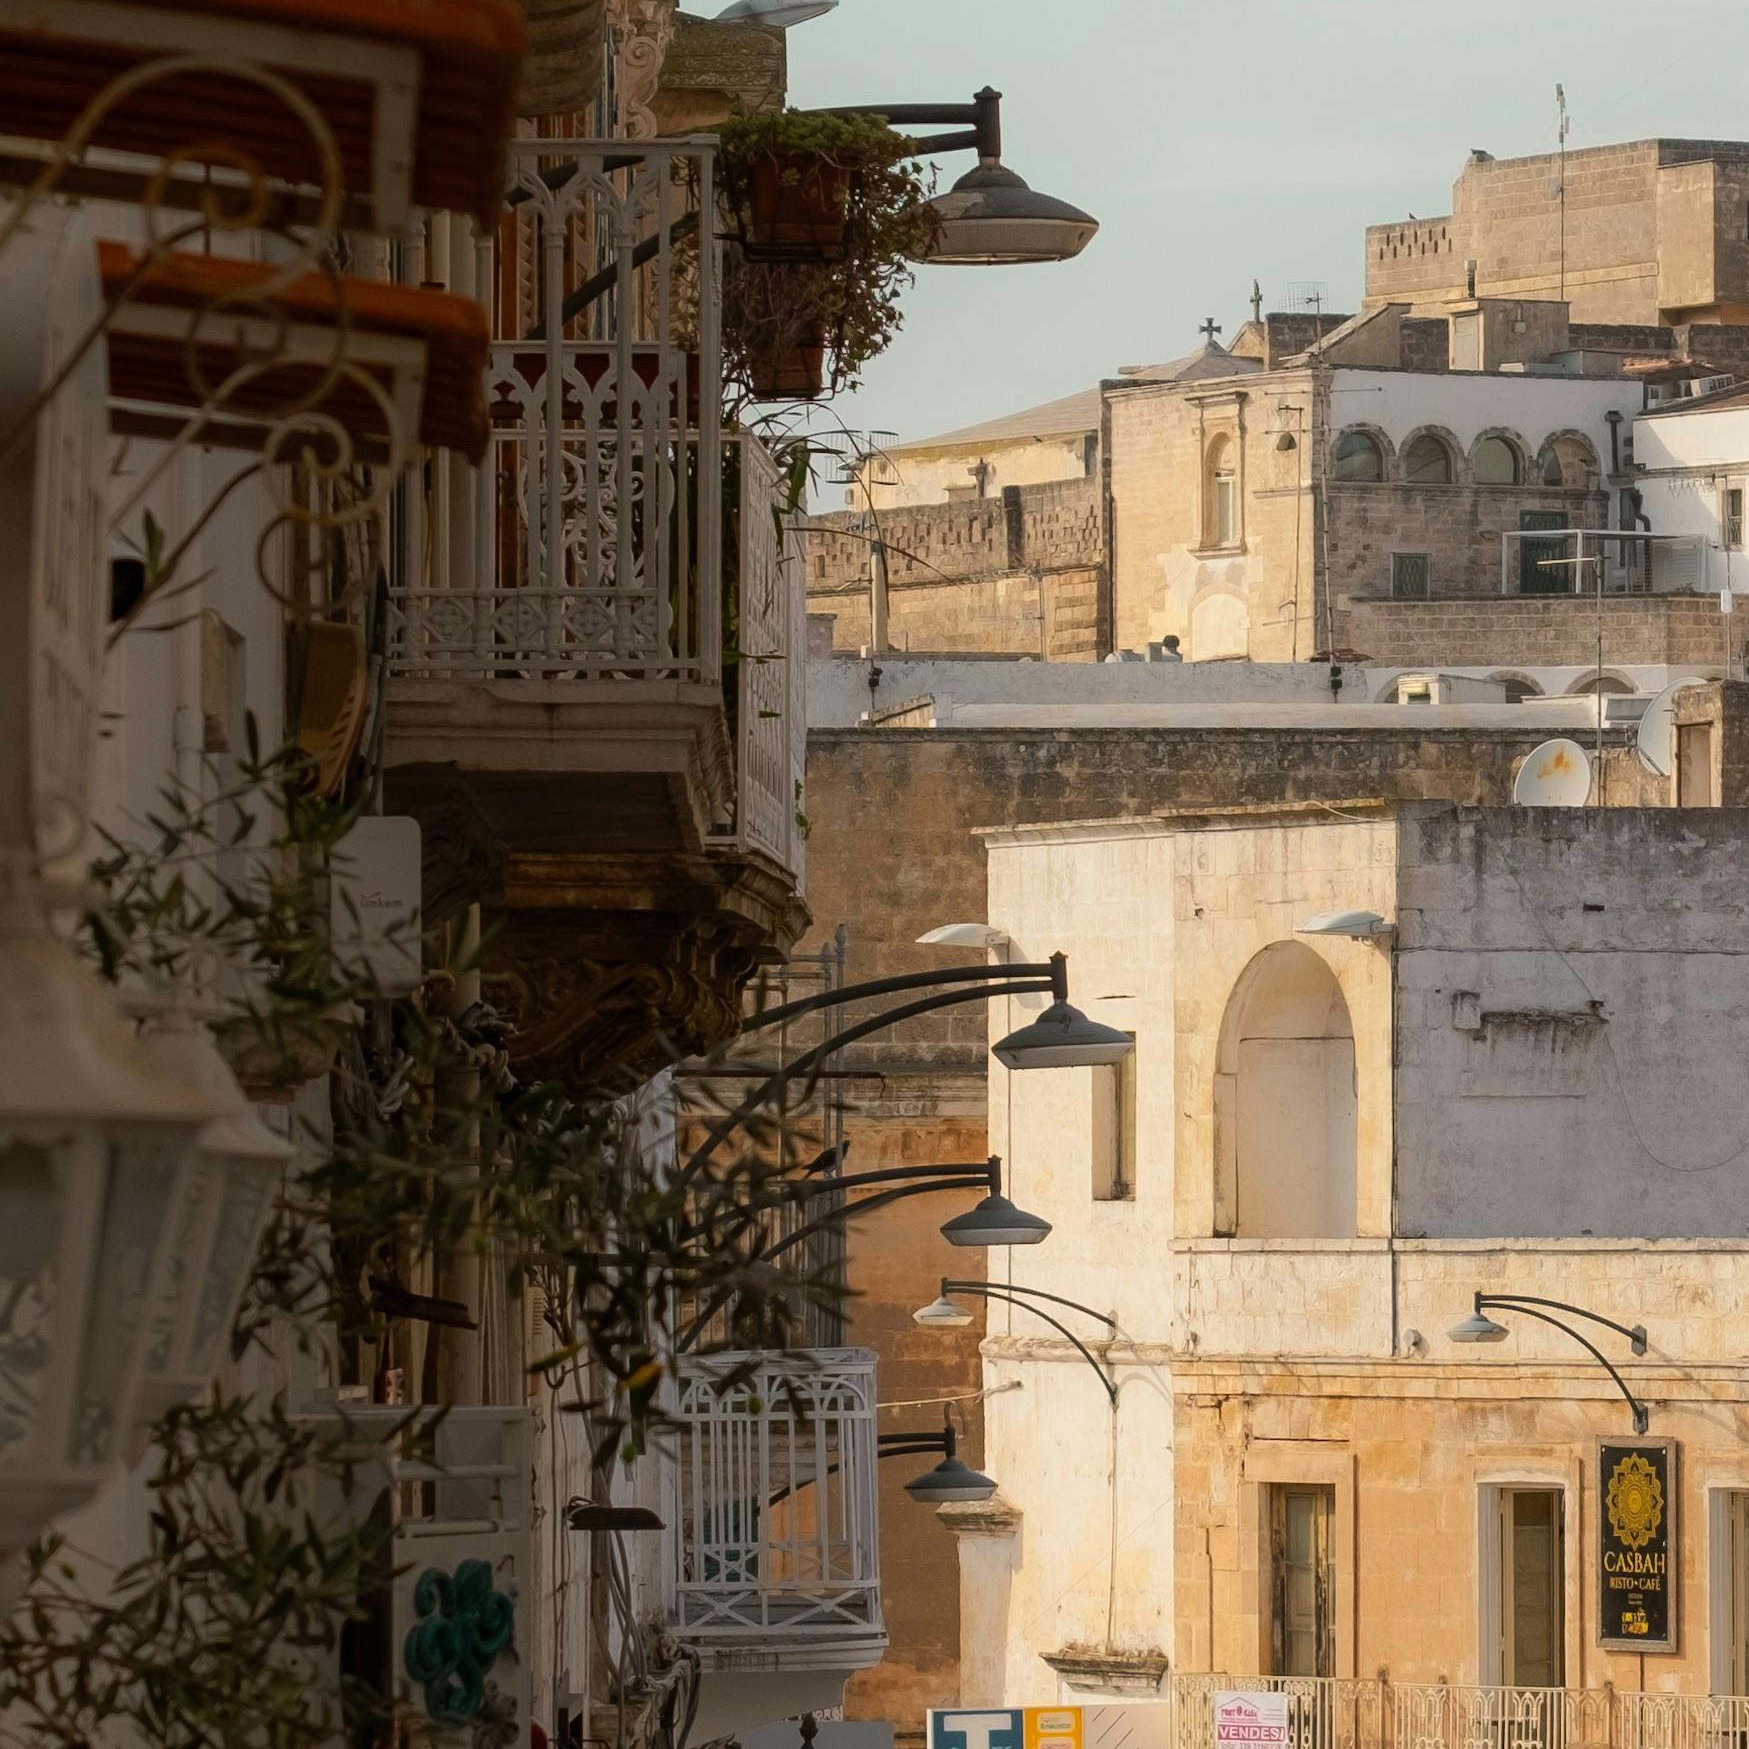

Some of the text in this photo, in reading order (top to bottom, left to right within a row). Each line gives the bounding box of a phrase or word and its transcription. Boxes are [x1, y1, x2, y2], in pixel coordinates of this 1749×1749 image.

[1603, 1551, 1665, 1574] CASBAH
[1609, 1577, 1633, 1590] RISTO
[1218, 1726, 1284, 1741] VENDESI
